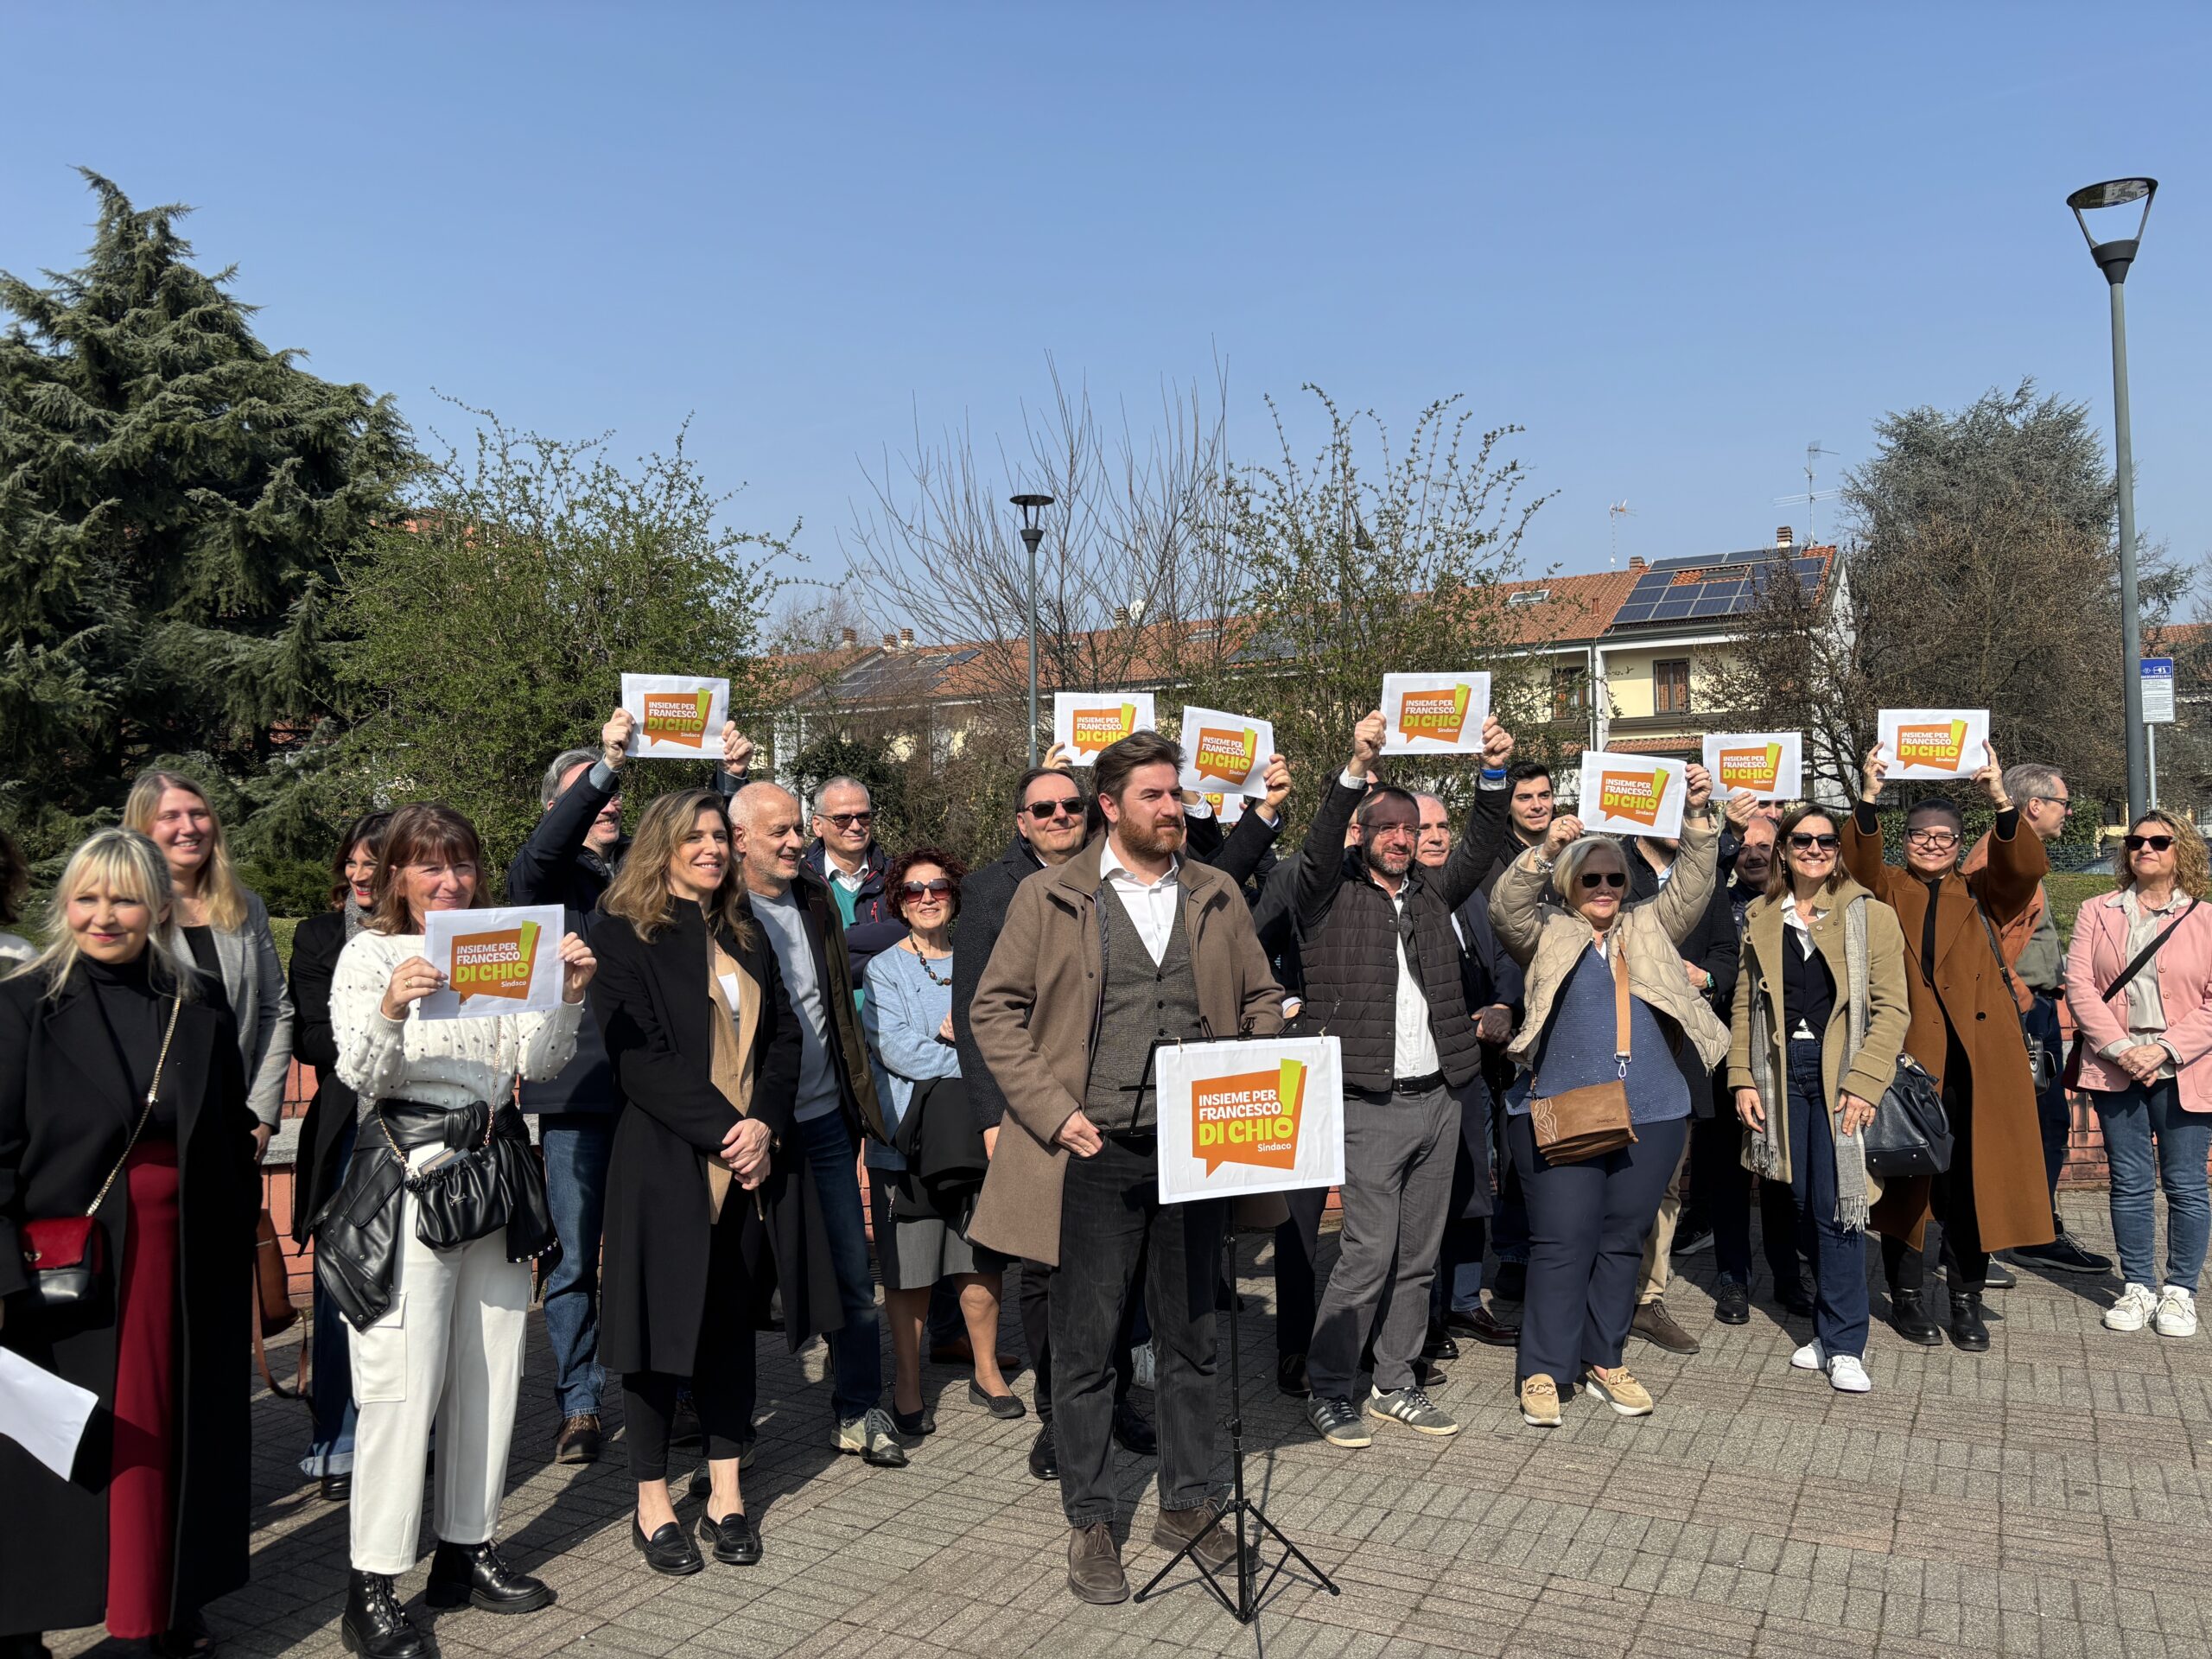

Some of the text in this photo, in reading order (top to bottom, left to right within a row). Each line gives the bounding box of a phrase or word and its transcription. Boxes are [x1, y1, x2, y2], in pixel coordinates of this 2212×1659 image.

[649, 709, 697, 718] FRANCESCO
[648, 717, 703, 732] DI CHIO
[1403, 715, 1460, 727] DI CHIO
[1077, 731, 1091, 741] DI
[1203, 736, 1230, 746] INSIEME
[1202, 743, 1245, 756] FRANCESCO
[1901, 746, 1958, 756] DI CHIO
[1199, 752, 1250, 770] DI CHIO
[1723, 769, 1774, 779] DI CHIO
[1605, 779, 1637, 787] INSIEME
[1605, 785, 1652, 796] FRANCESCO
[1604, 793, 1656, 810] DI CHIO
[457, 944, 498, 954] INSIEME
[457, 951, 520, 964] FRANCESCO
[456, 963, 529, 982] DI CHIO
[1199, 1090, 1276, 1106] INSIEME PER
[1199, 1102, 1281, 1121] FRANCESCO
[1199, 1117, 1294, 1146] DI CHIO
[1258, 1142, 1291, 1152] Sindaco
